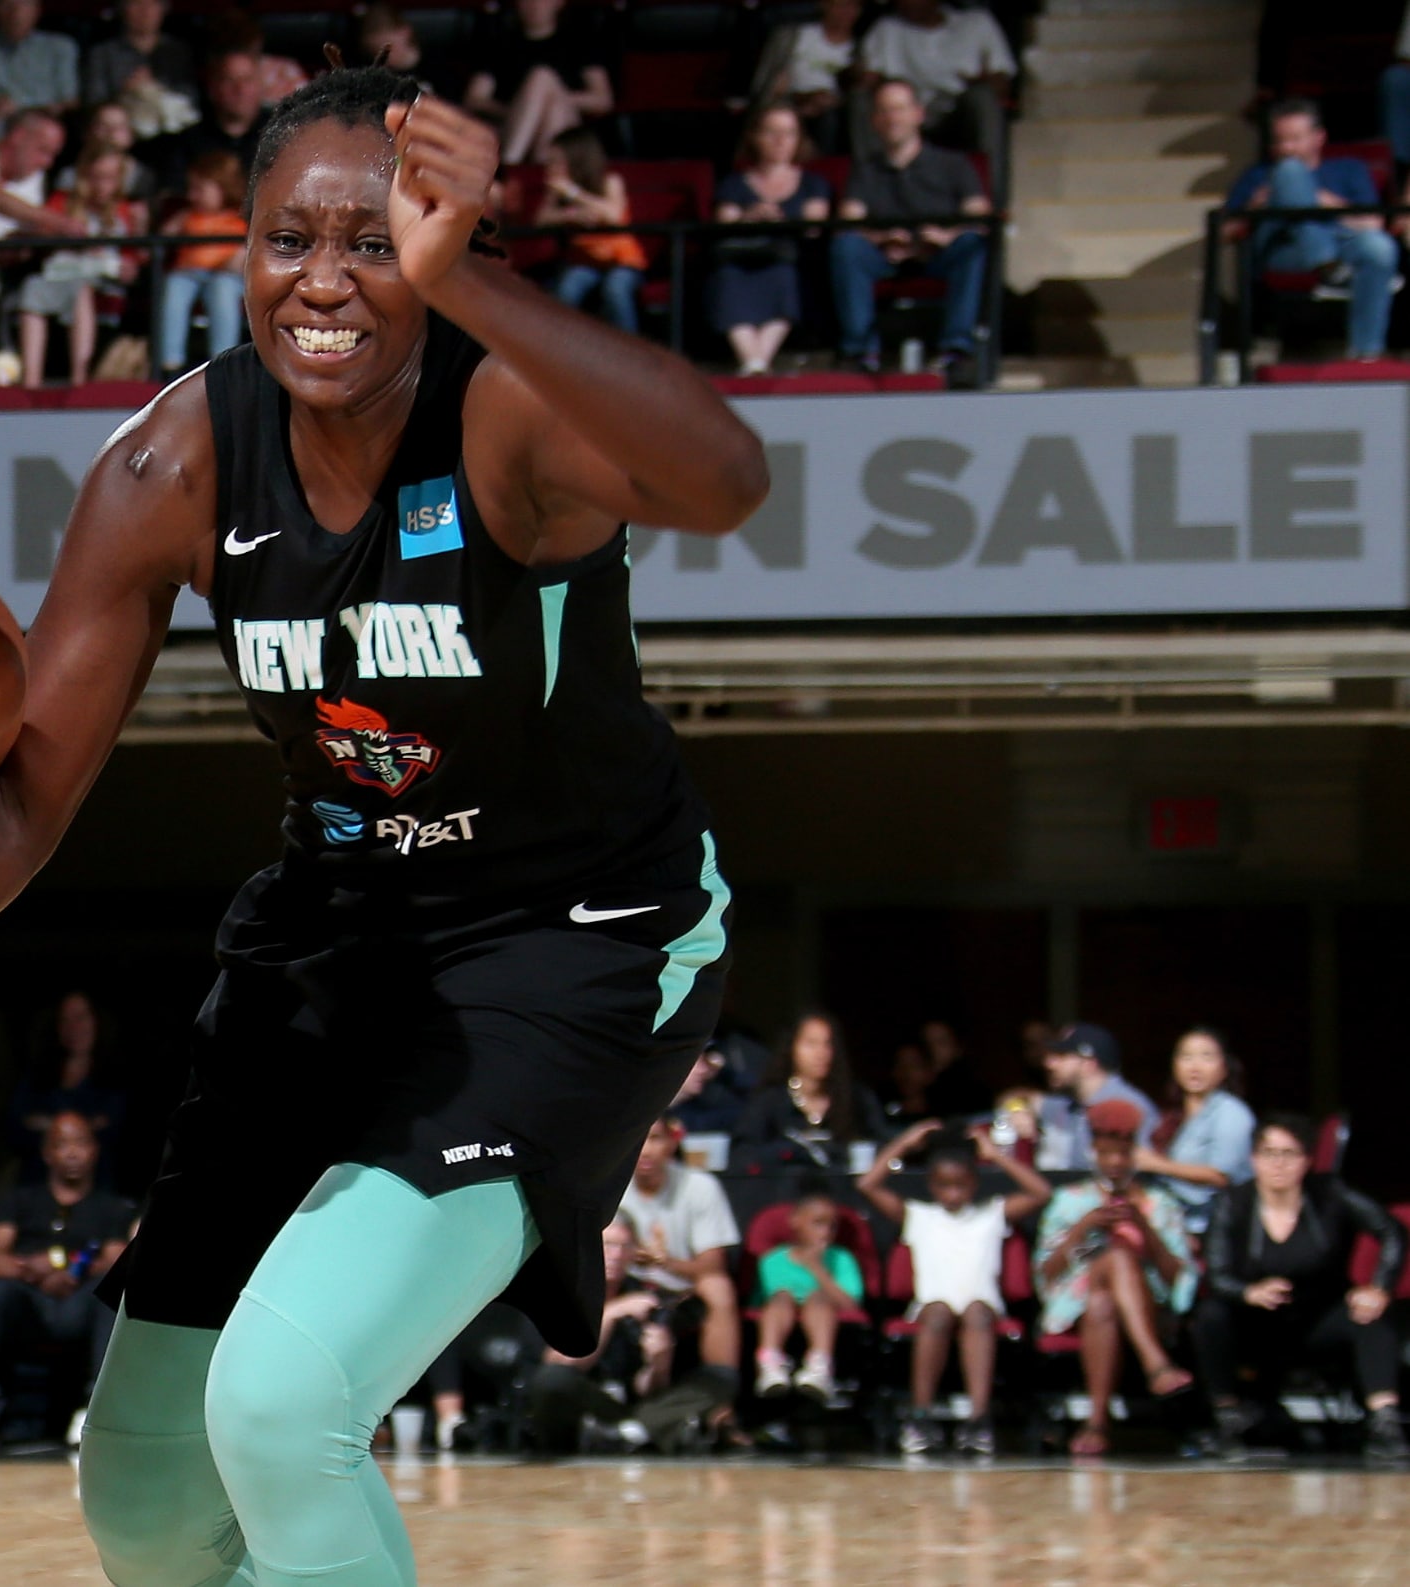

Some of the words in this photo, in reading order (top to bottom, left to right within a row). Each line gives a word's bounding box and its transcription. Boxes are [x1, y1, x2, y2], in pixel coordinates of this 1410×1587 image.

[405, 502, 455, 533] HSS
[854, 429, 1364, 572] SALE
[233, 618, 325, 693] NEW
[339, 601, 483, 679] YORK
[376, 808, 481, 856] AT&T
[441, 1143, 482, 1165] NEW
